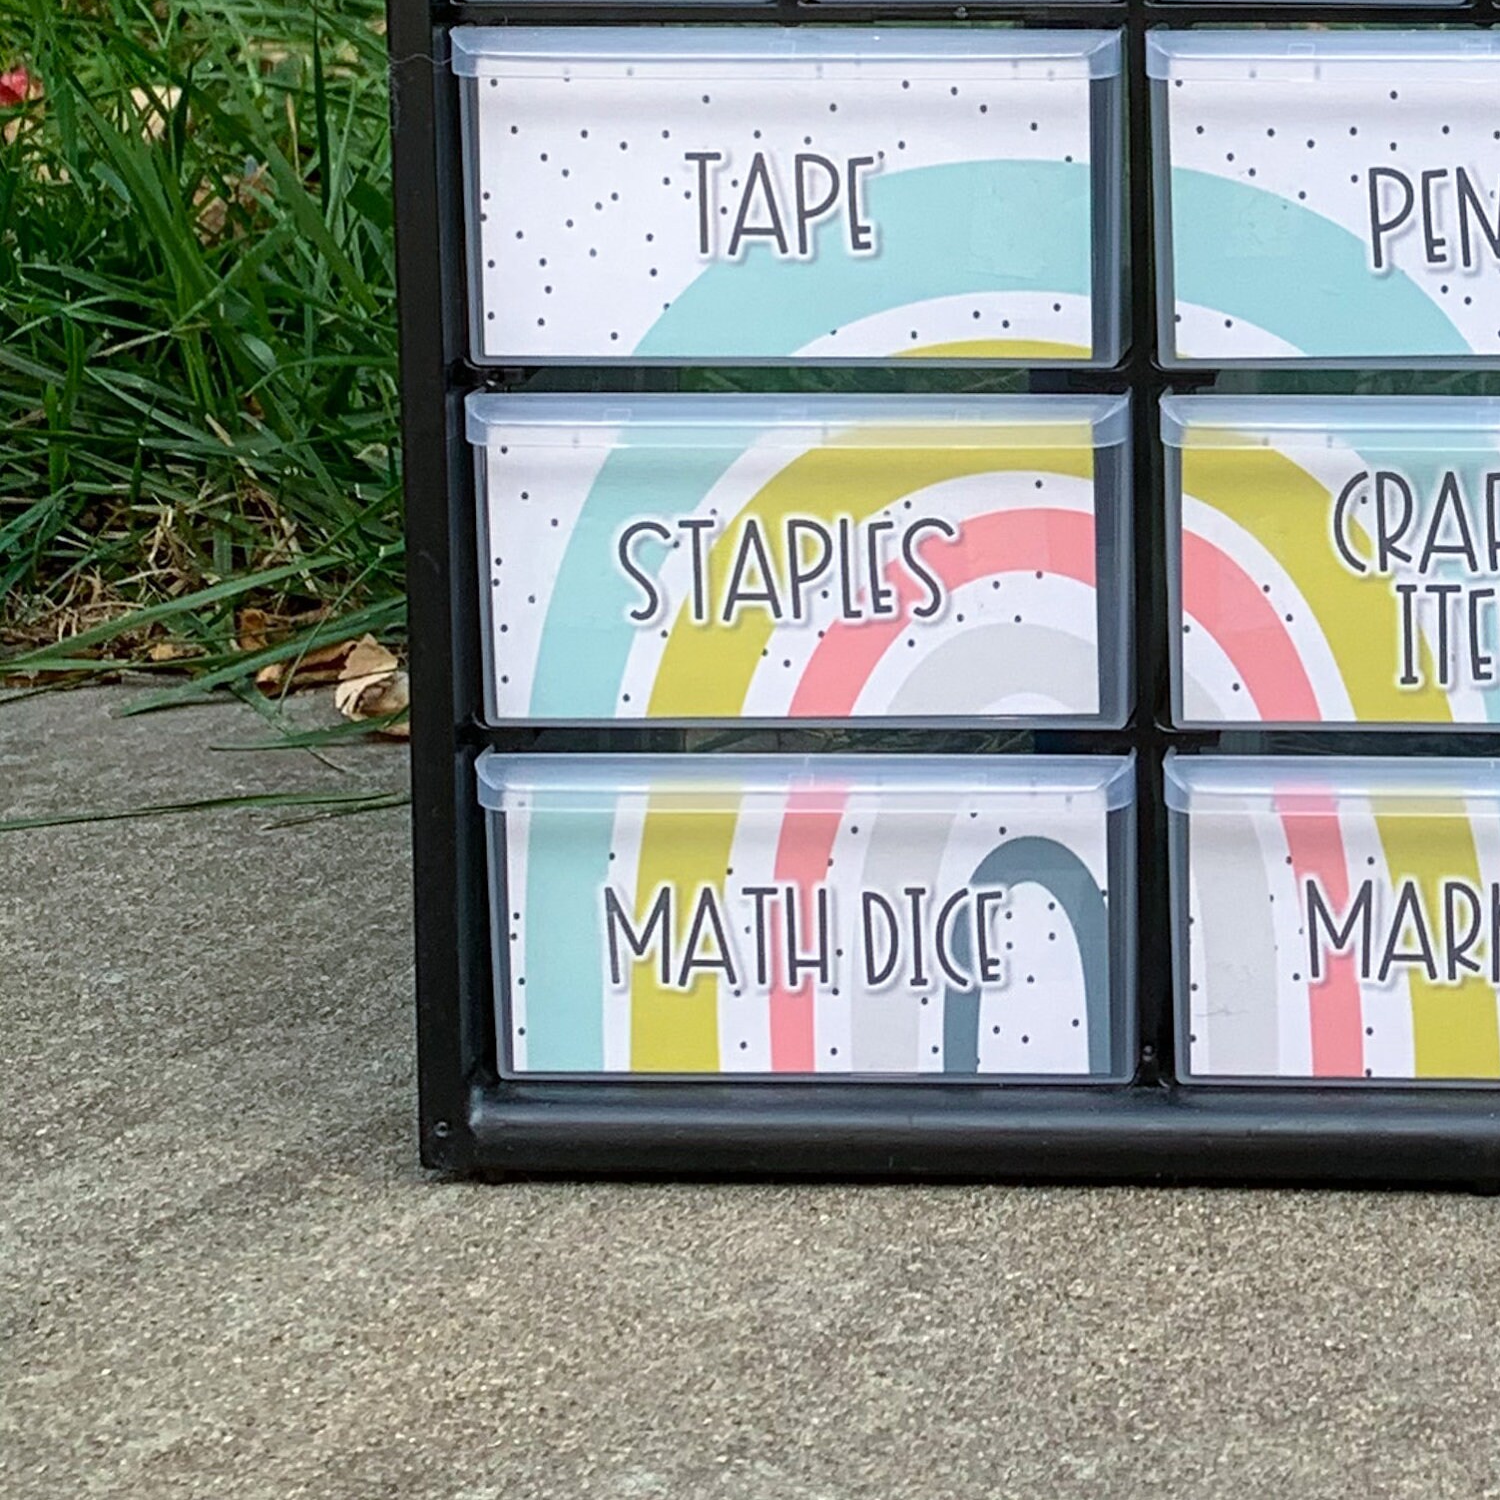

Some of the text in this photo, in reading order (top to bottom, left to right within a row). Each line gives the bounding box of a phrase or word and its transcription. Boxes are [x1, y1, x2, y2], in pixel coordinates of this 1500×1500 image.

[684, 151, 875, 256] TAPE
[618, 517, 958, 622] STAPLES
[605, 884, 1004, 987] MATH DICE
